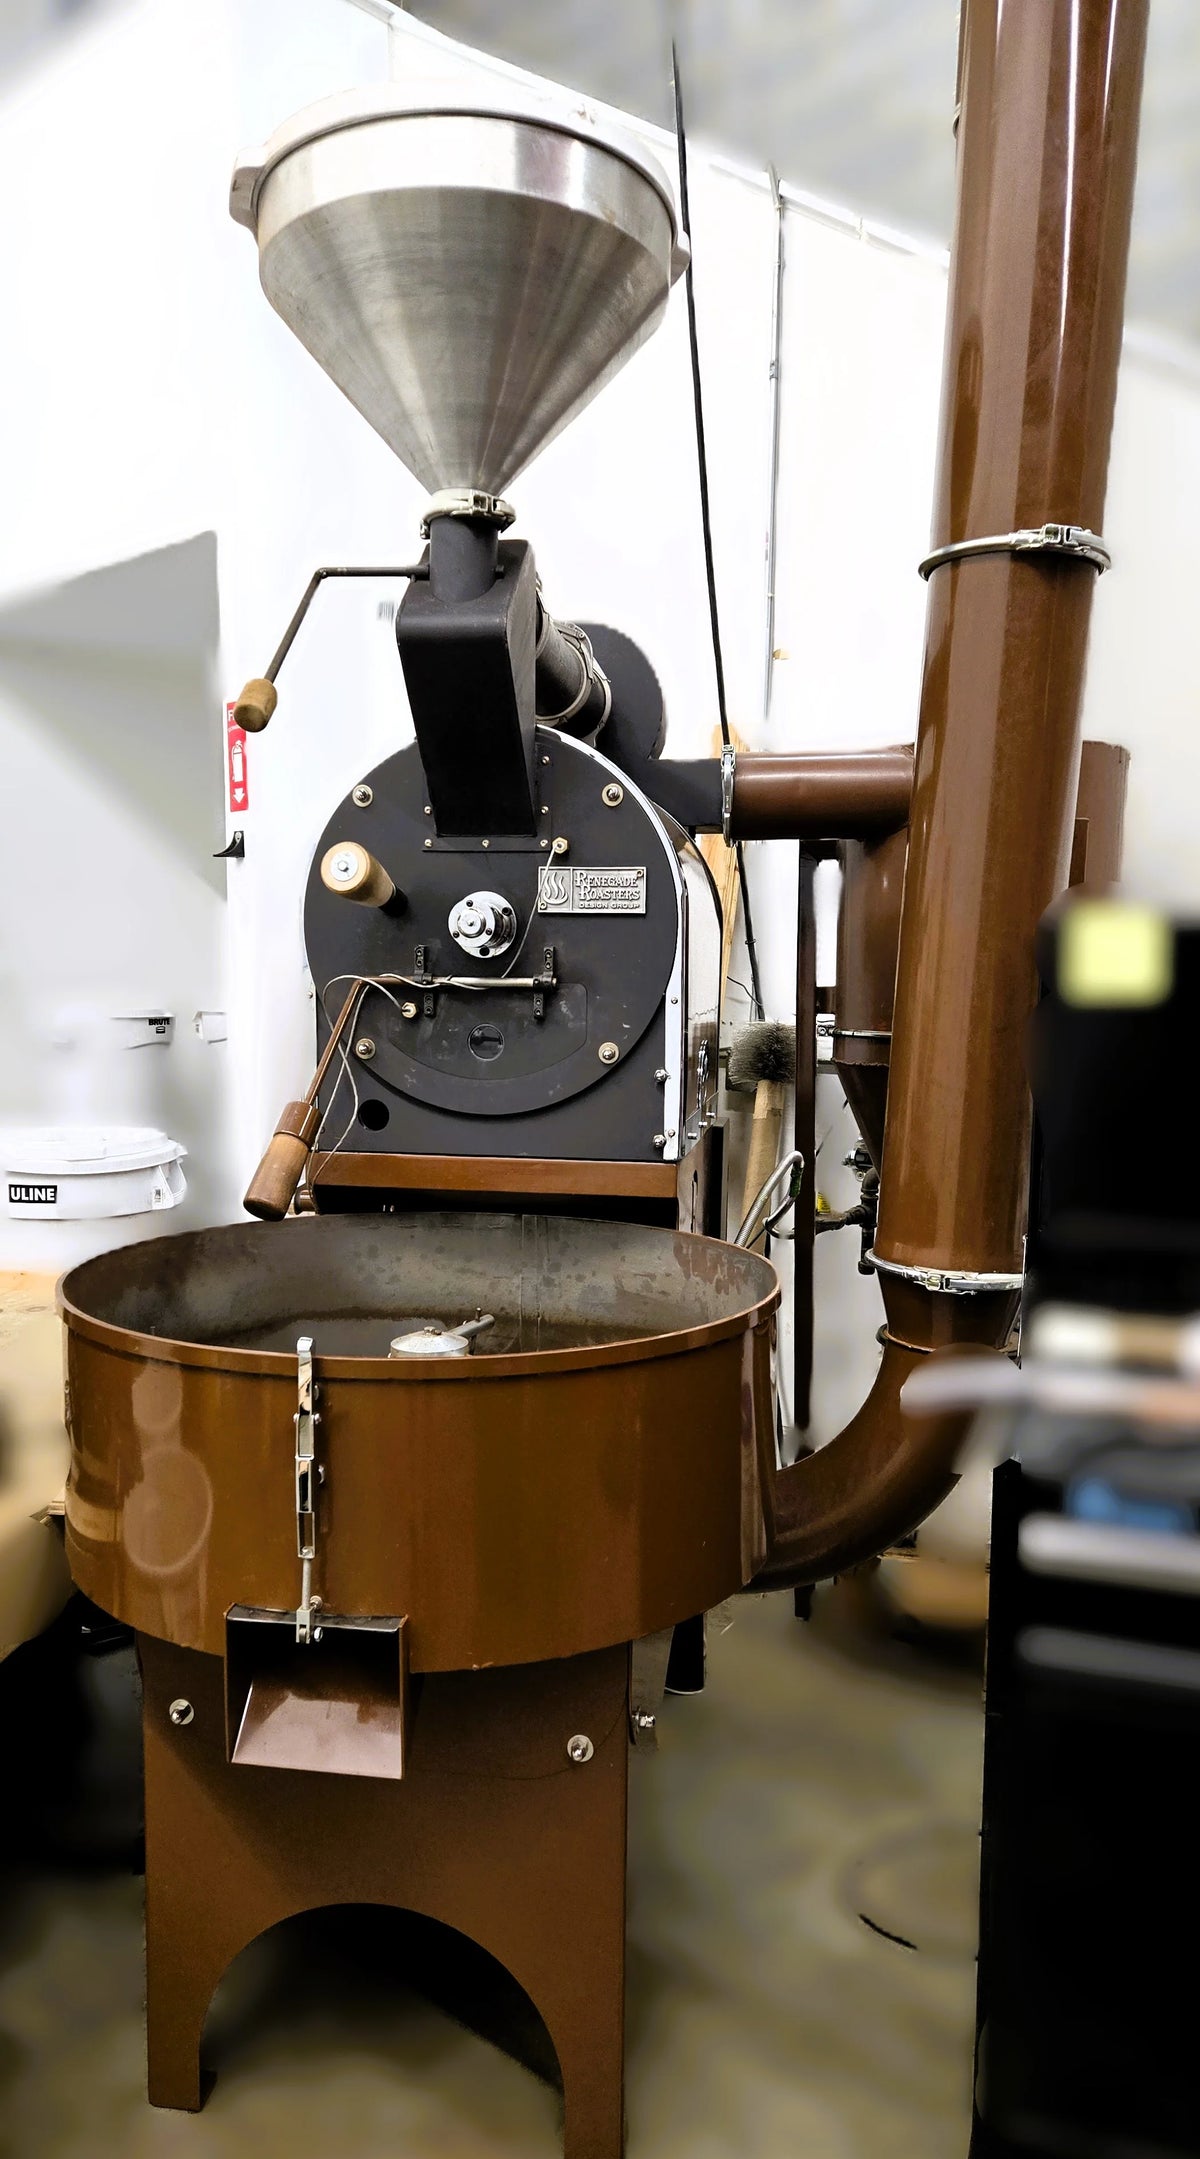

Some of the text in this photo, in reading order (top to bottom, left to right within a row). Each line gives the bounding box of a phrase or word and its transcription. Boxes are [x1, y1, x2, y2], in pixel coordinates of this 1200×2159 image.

[575, 871, 638, 887] RENEGADE
[579, 885, 640, 901] ROASTERS
[10, 1187, 55, 1201] ULINE
